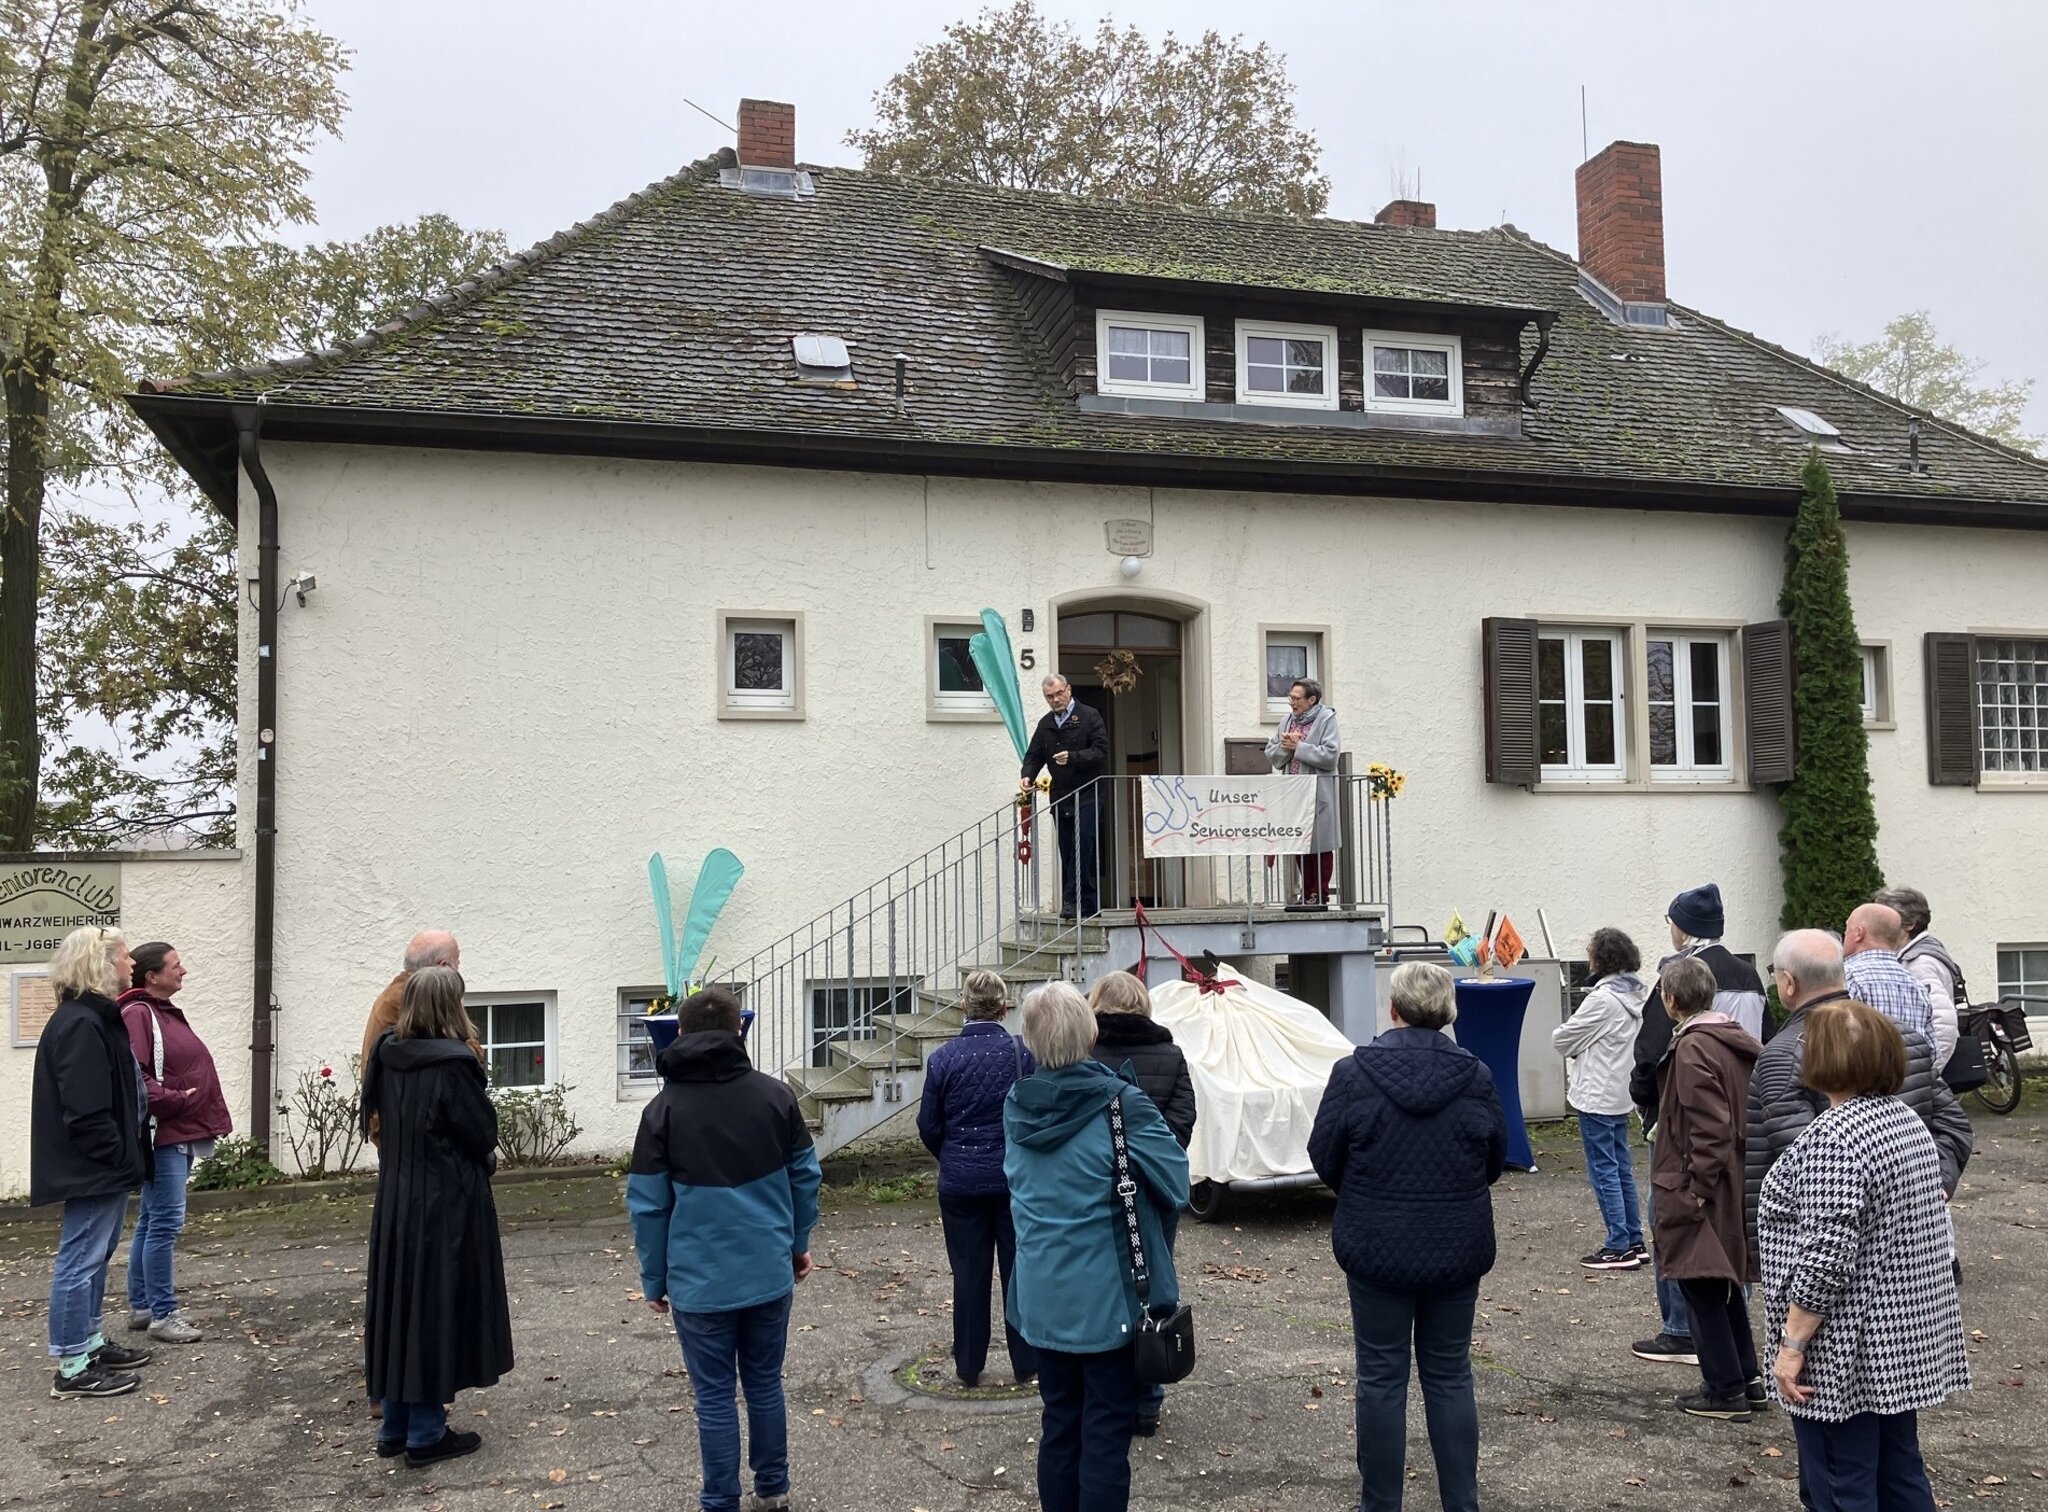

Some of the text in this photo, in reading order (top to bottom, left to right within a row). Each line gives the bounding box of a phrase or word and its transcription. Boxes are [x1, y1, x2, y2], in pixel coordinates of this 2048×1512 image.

[1020, 649, 1035, 670] 5
[1208, 789, 1259, 804] Unser
[1190, 822, 1303, 837] Senioreschees
[0, 914, 120, 929] WARZWEIHERHOF
